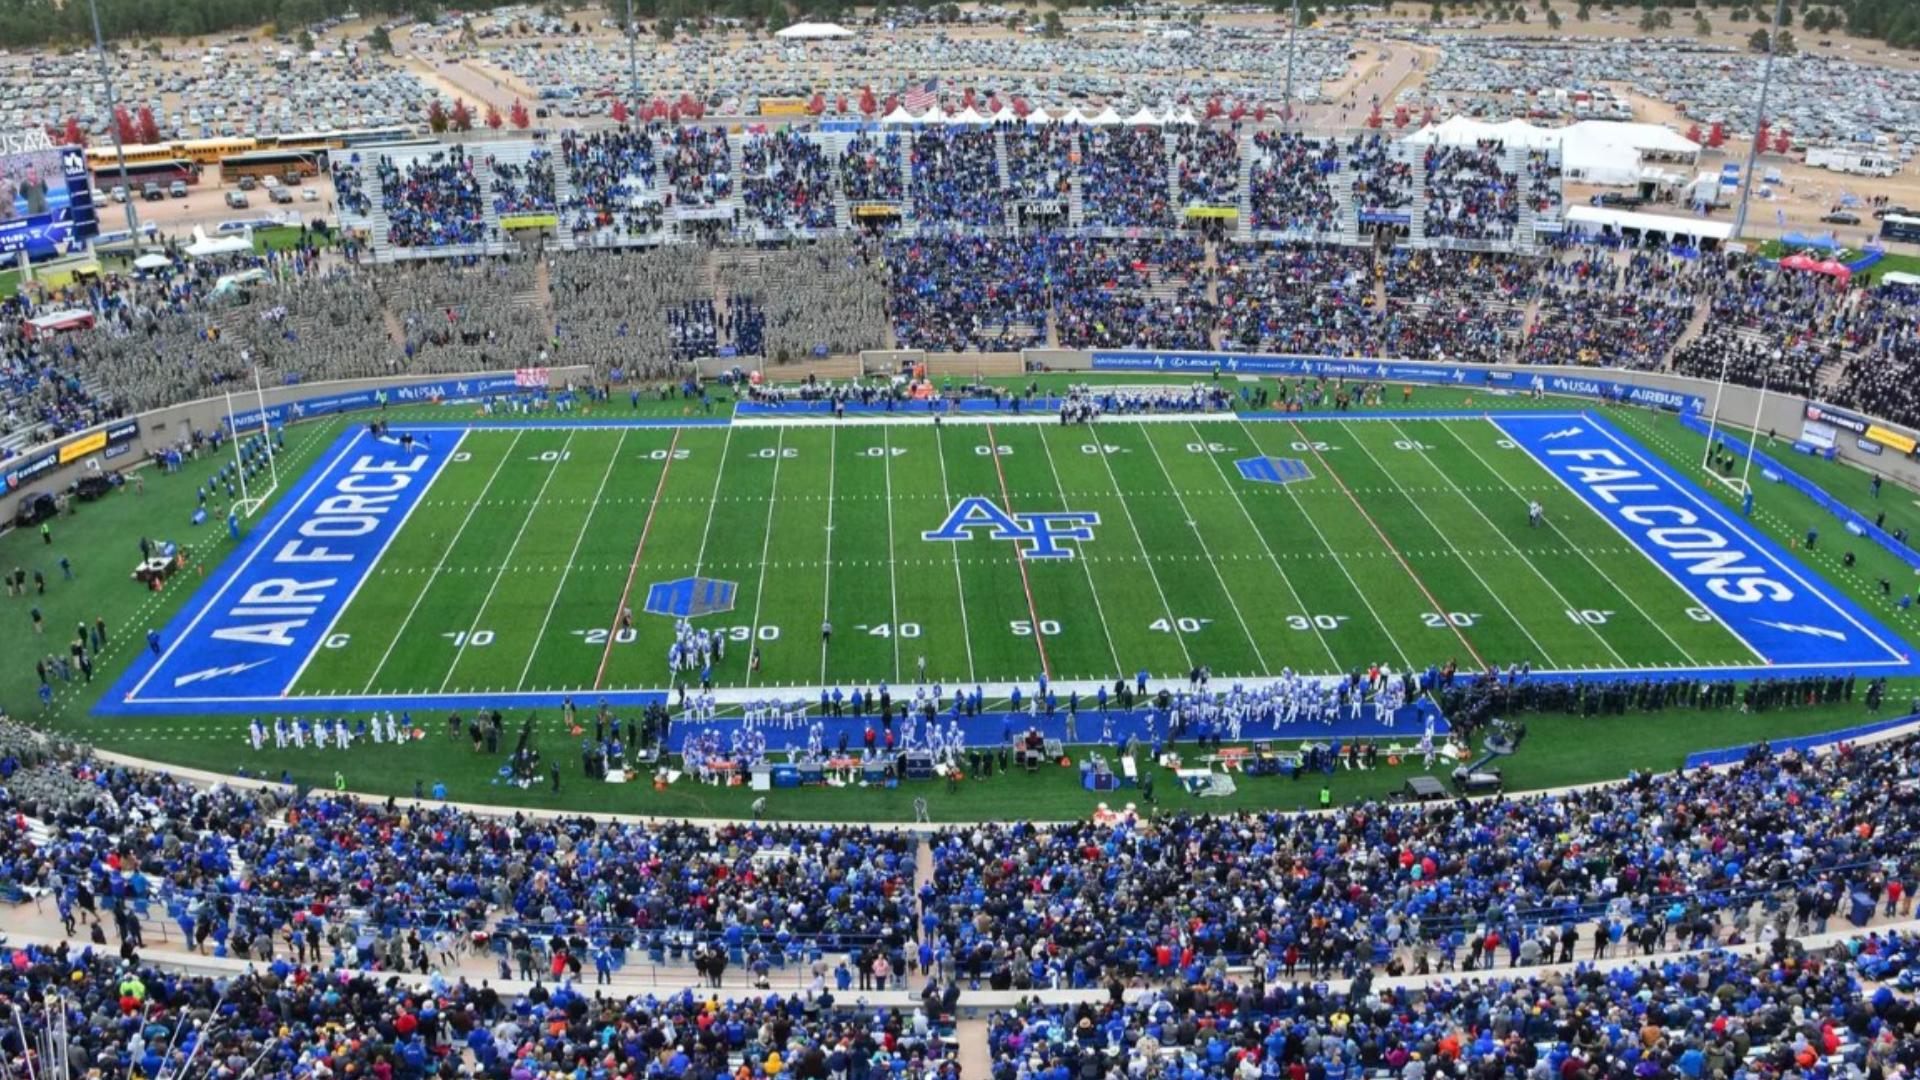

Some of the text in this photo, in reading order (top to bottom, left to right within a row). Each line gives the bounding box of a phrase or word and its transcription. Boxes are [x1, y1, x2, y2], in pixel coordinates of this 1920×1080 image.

[414, 385, 446, 399] USAA
[1569, 380, 1600, 394] USAA
[1630, 388, 1684, 407] AIRBUS
[234, 409, 281, 426] NISSAN
[273, 454, 430, 563] FORCE
[921, 496, 1101, 559] AF
[1546, 447, 1795, 604] FALCONS
[210, 576, 338, 647] AIR
[1565, 608, 1609, 625] 10
[1684, 607, 1714, 622] G
[1010, 620, 1062, 636] 50
[1148, 617, 1202, 632] 40
[1285, 615, 1339, 630] 30
[1420, 613, 1476, 627] 20
[453, 630, 496, 646] 10
[584, 628, 638, 643] 20
[728, 625, 780, 640] 30
[868, 623, 922, 638] 40
[324, 633, 351, 649] G
